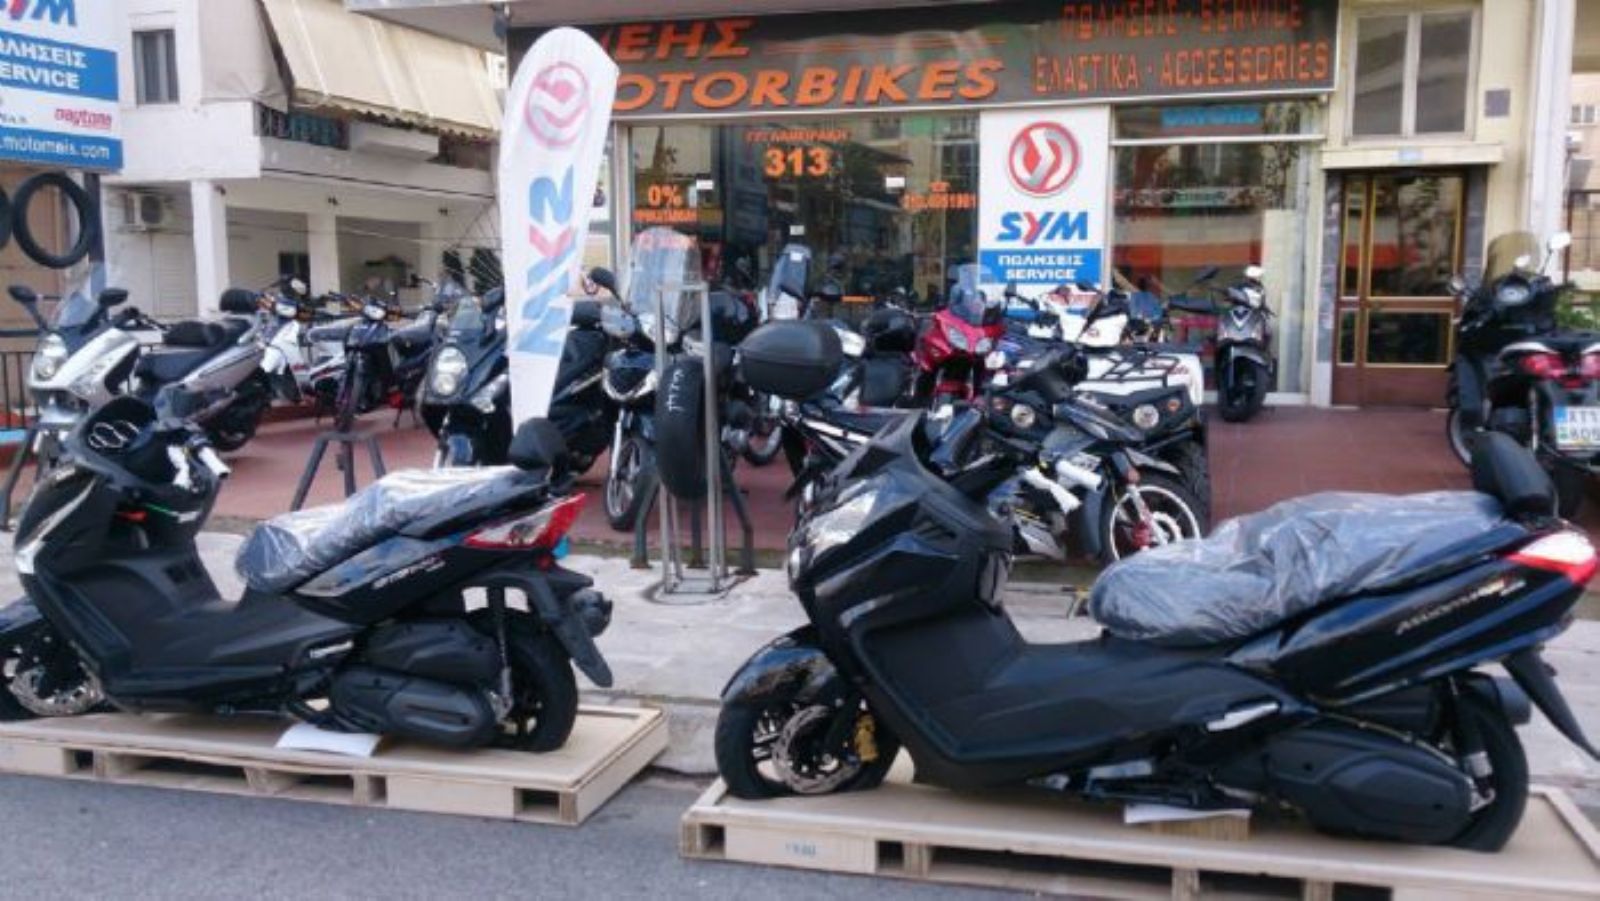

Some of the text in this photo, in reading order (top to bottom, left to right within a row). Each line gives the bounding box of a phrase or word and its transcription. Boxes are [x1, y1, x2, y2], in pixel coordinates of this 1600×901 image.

[0, 0, 77, 27] YM
[1200, 0, 1303, 33] SERVICE
[602, 18, 755, 60] ΕΗΣ
[0, 60, 80, 90] ERVICE
[1033, 41, 1330, 94] ΕΛΑΣΤΙΚΑ ACCESSORIES
[613, 60, 1003, 110] OTORBIKES
[764, 147, 829, 177] 313
[648, 184, 683, 207] 0%
[996, 211, 1088, 245] SYM
[1006, 268, 1077, 280] SERVICE
